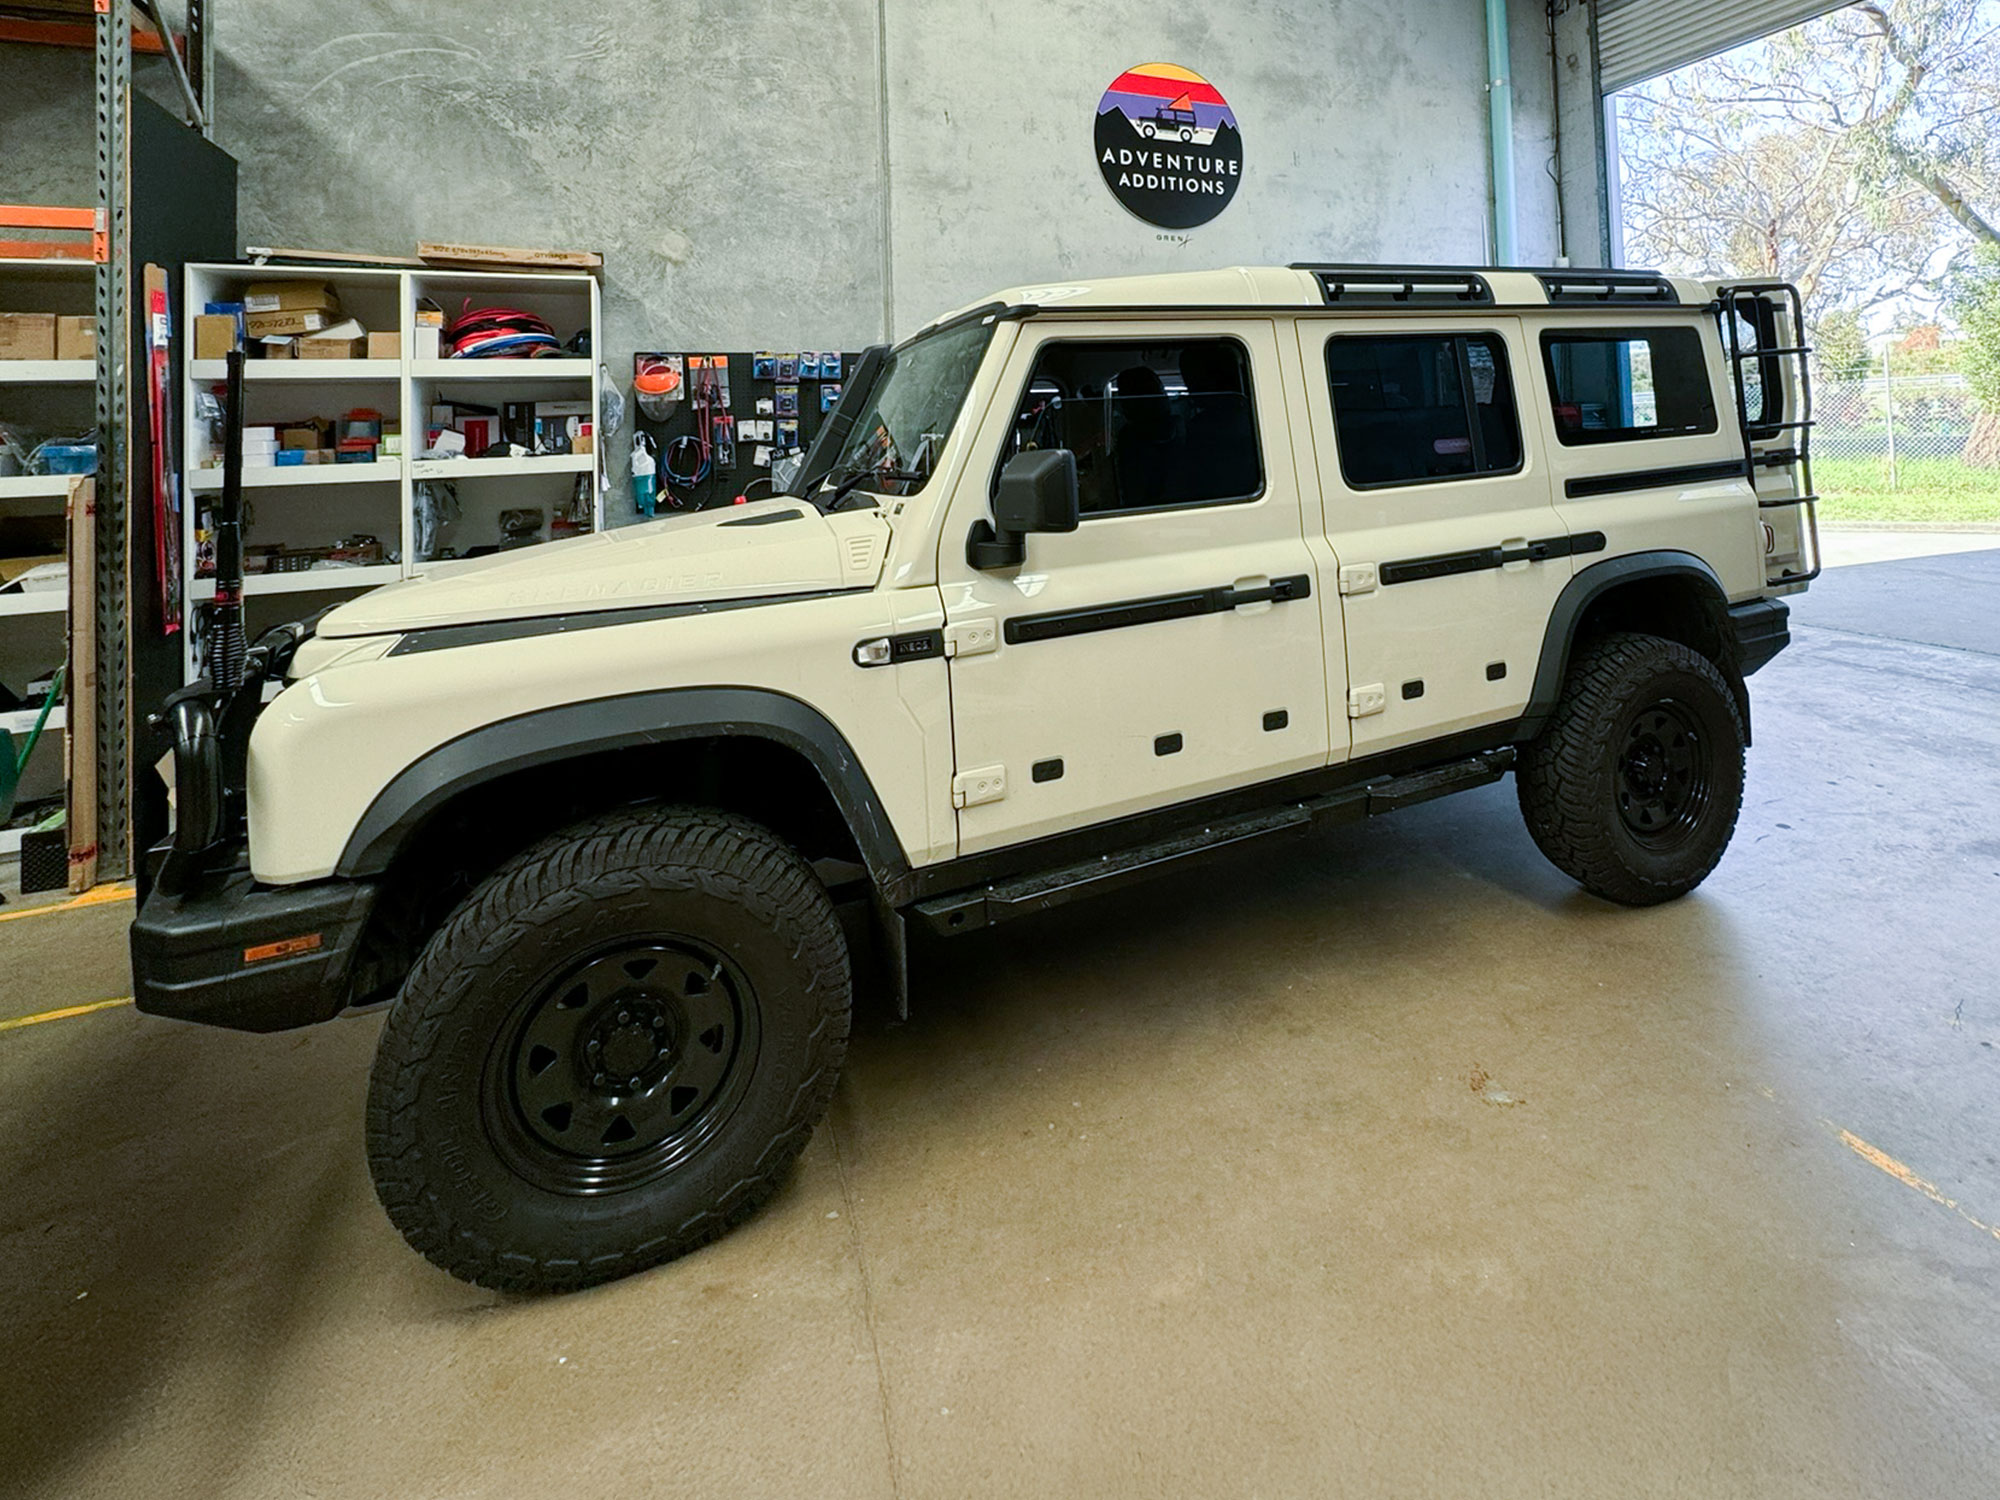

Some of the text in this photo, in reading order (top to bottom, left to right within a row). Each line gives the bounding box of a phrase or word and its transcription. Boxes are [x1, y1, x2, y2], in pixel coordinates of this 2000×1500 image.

[1103, 148, 1238, 175] ADVENTURE
[1119, 173, 1225, 195] ADDITIONS
[509, 572, 723, 605] GRENADIER
[899, 640, 929, 653] INEOS
